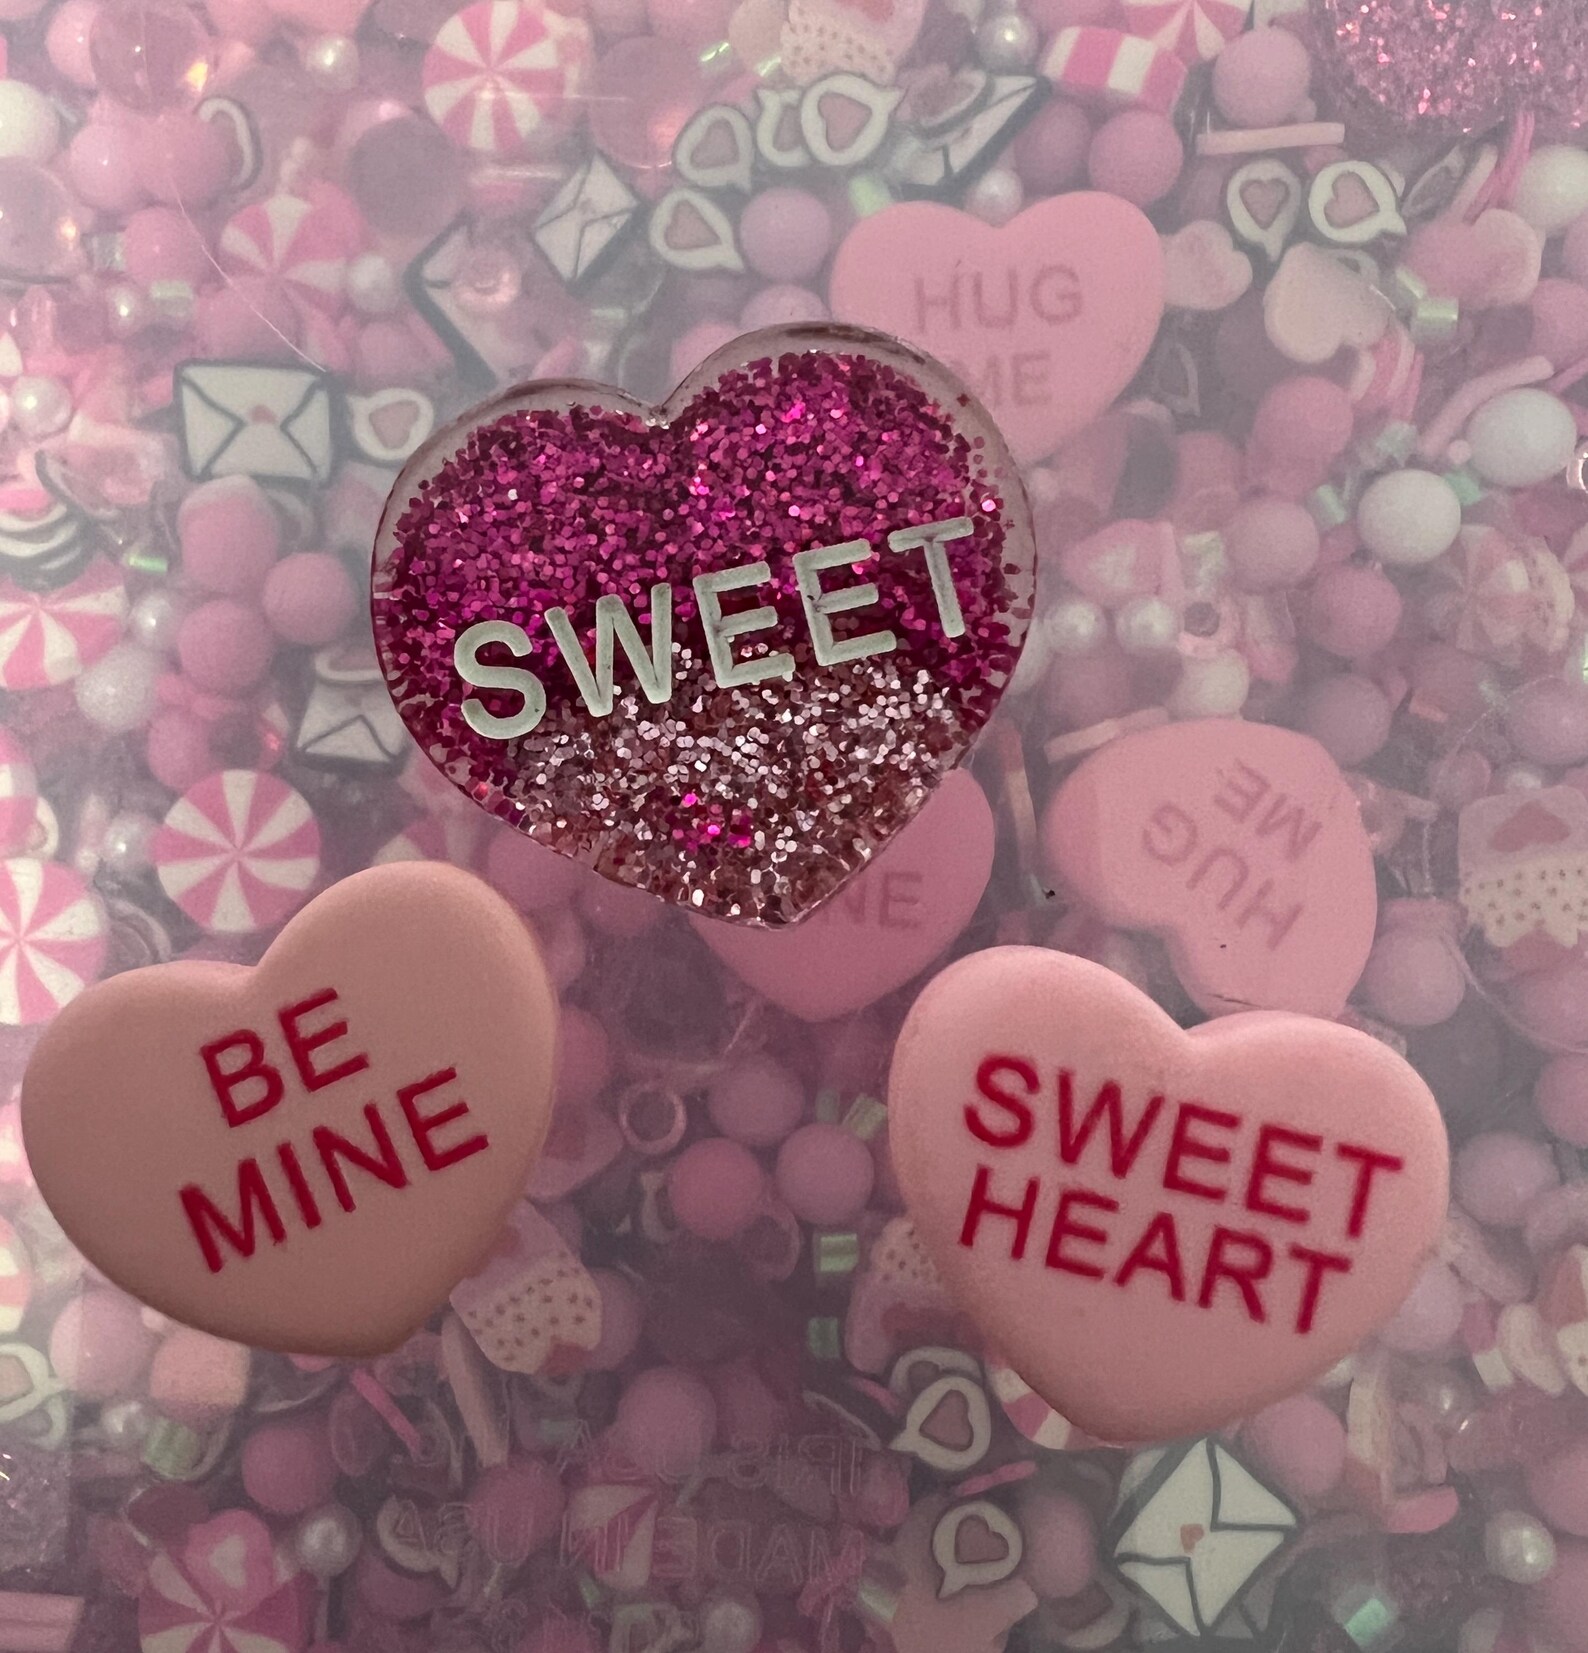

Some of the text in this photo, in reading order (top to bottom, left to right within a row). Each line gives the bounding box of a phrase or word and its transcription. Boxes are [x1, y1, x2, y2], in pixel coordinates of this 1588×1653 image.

[914, 263, 1083, 334] HUG
[453, 515, 975, 740] SWEET
[1142, 803, 1304, 951] HUG
[1212, 757, 1323, 864] ME
[200, 987, 370, 1128] BE
[179, 1064, 490, 1273] MINE
[963, 1053, 1404, 1240] SWEET
[959, 1162, 1353, 1335] HEART
